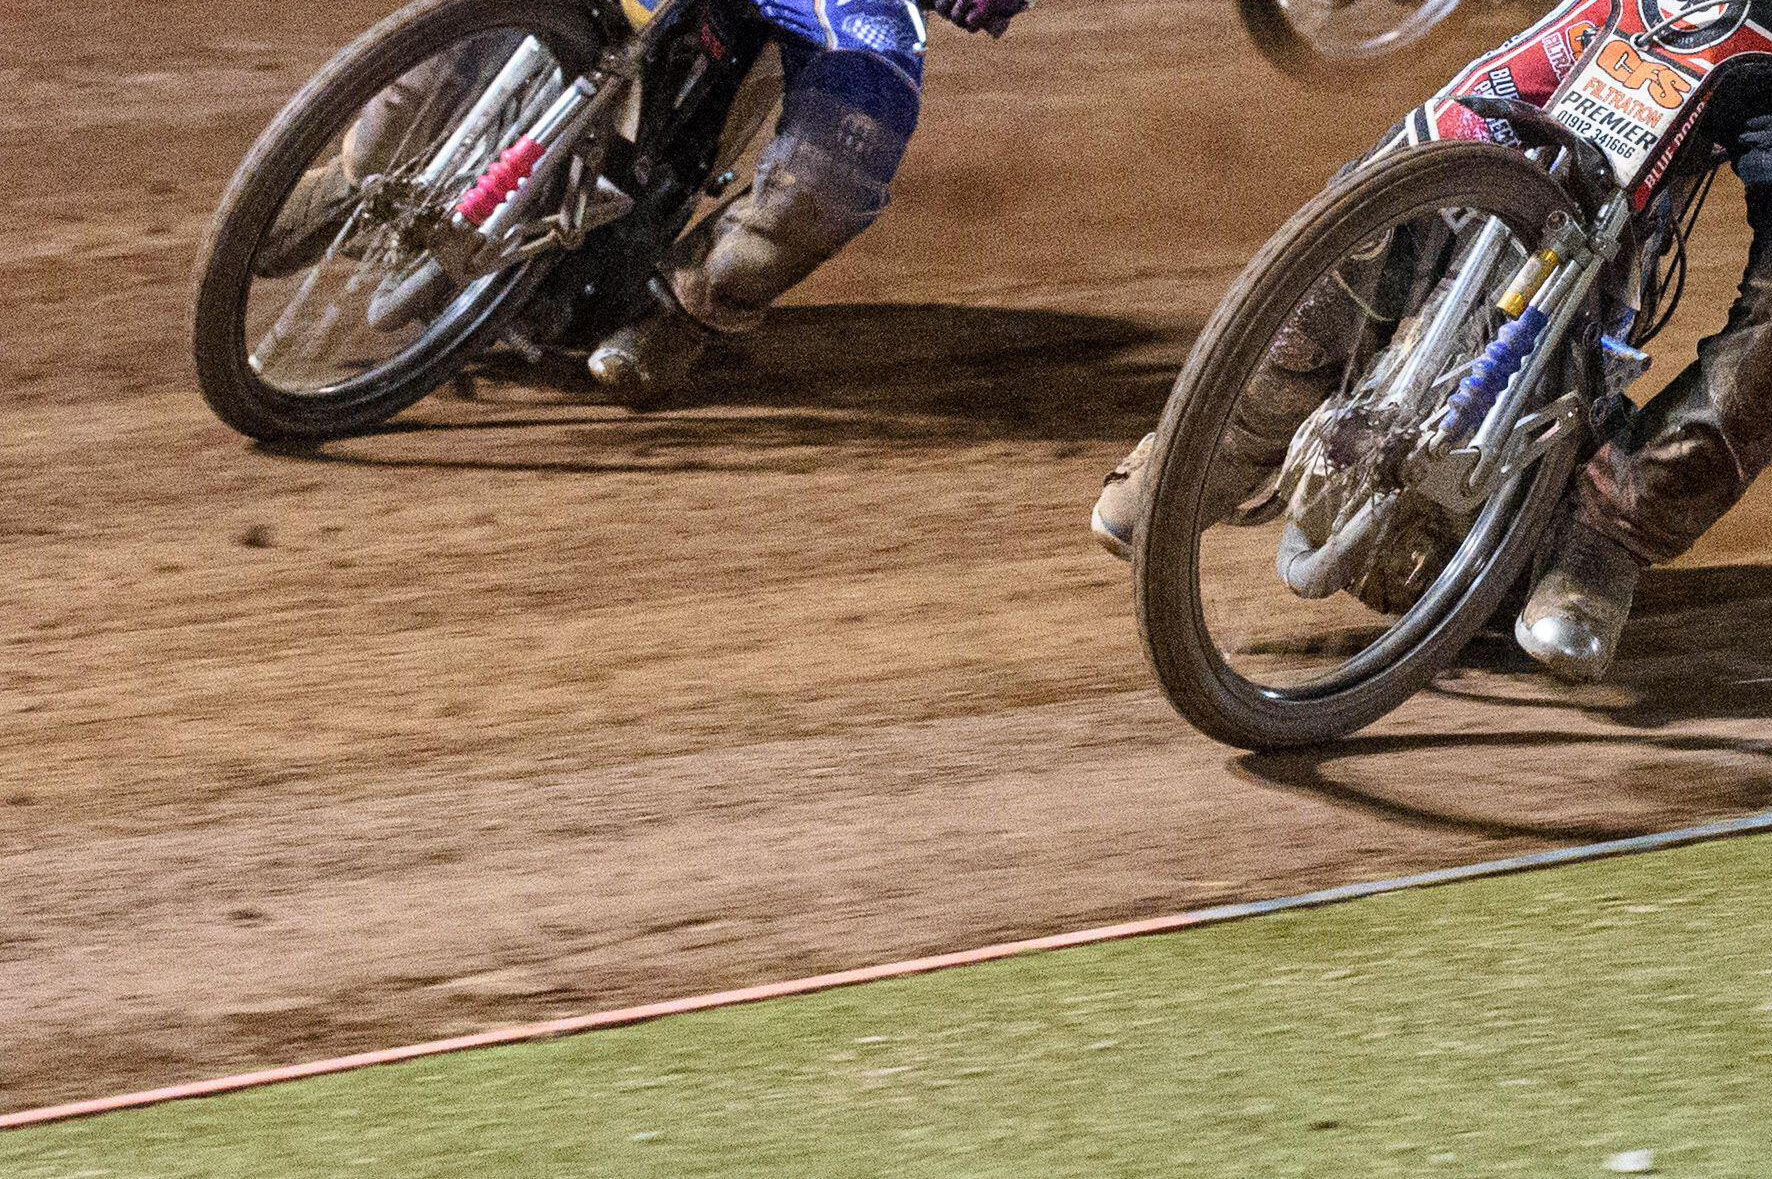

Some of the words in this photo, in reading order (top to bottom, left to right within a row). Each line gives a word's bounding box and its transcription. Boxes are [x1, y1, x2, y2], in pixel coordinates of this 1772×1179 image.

[1560, 90, 1660, 151] PREMIER
[1581, 75, 1664, 129] FILTRATION
[1556, 109, 1592, 135] 01912
[1590, 128, 1636, 159] 341666
